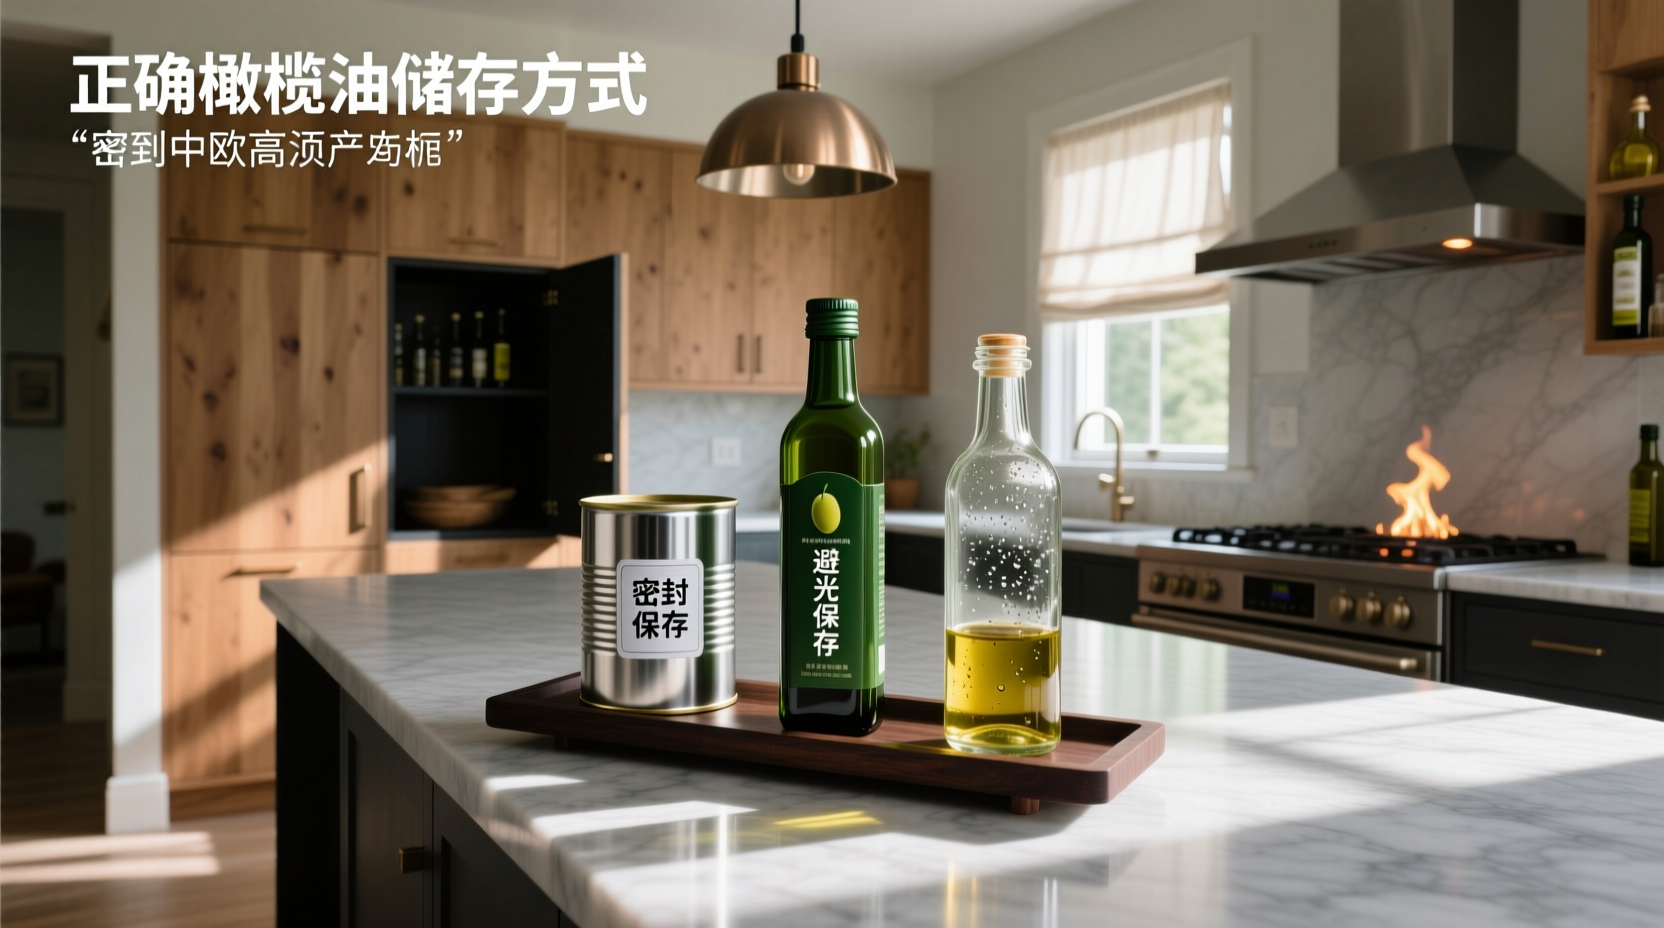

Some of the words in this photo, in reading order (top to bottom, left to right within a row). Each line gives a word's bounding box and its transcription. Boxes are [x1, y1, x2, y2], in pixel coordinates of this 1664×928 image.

[632, 577, 689, 607] 密封
[812, 548, 840, 657] 避光保存
[632, 610, 689, 640] 保存
